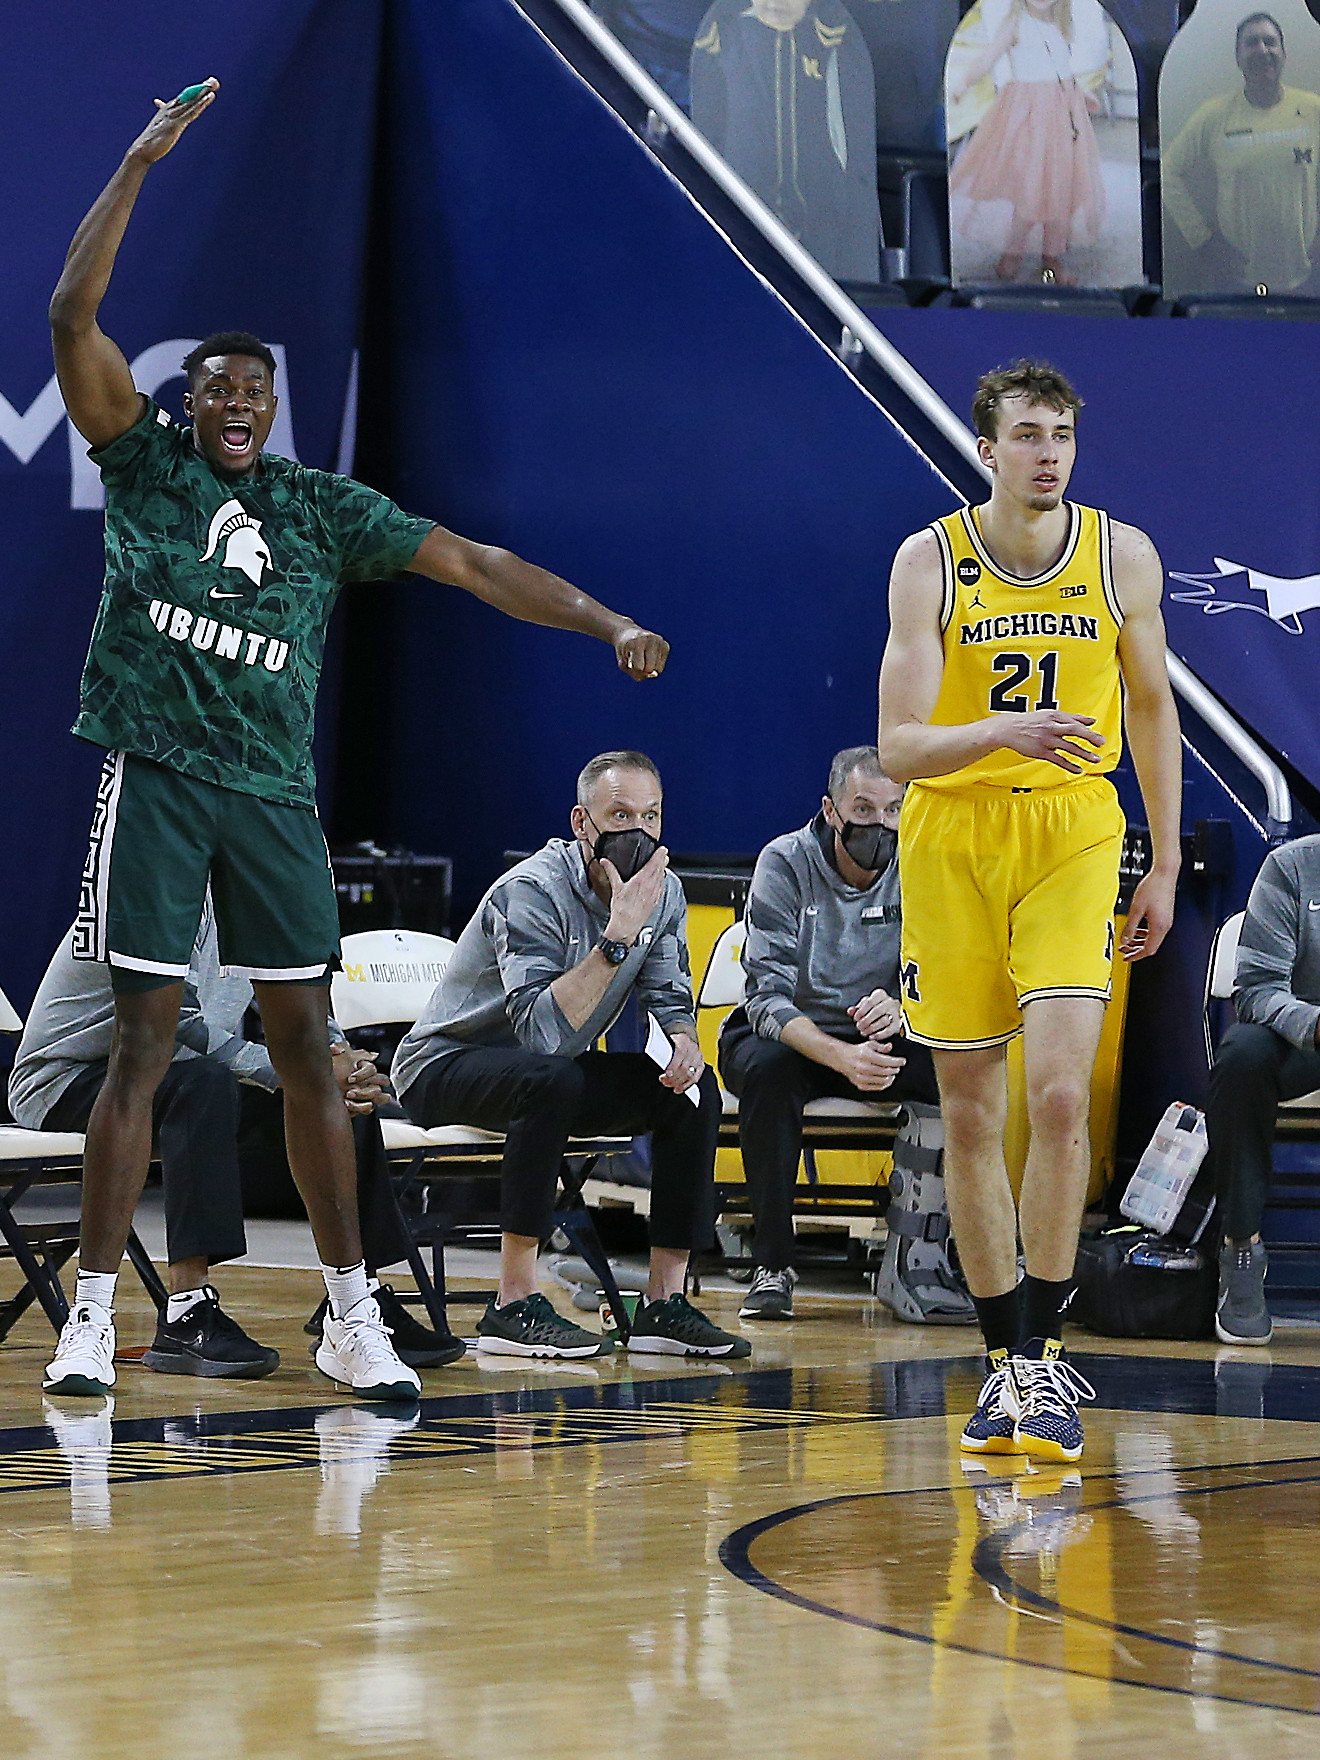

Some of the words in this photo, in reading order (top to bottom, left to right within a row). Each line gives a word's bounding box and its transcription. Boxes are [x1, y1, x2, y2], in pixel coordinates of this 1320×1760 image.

[959, 566, 979, 576] BLM
[148, 599, 289, 673] UBUNTU
[959, 613, 1099, 645] MICHIGAN
[989, 650, 1060, 713] 21
[369, 963, 420, 983] MICHIGAN
